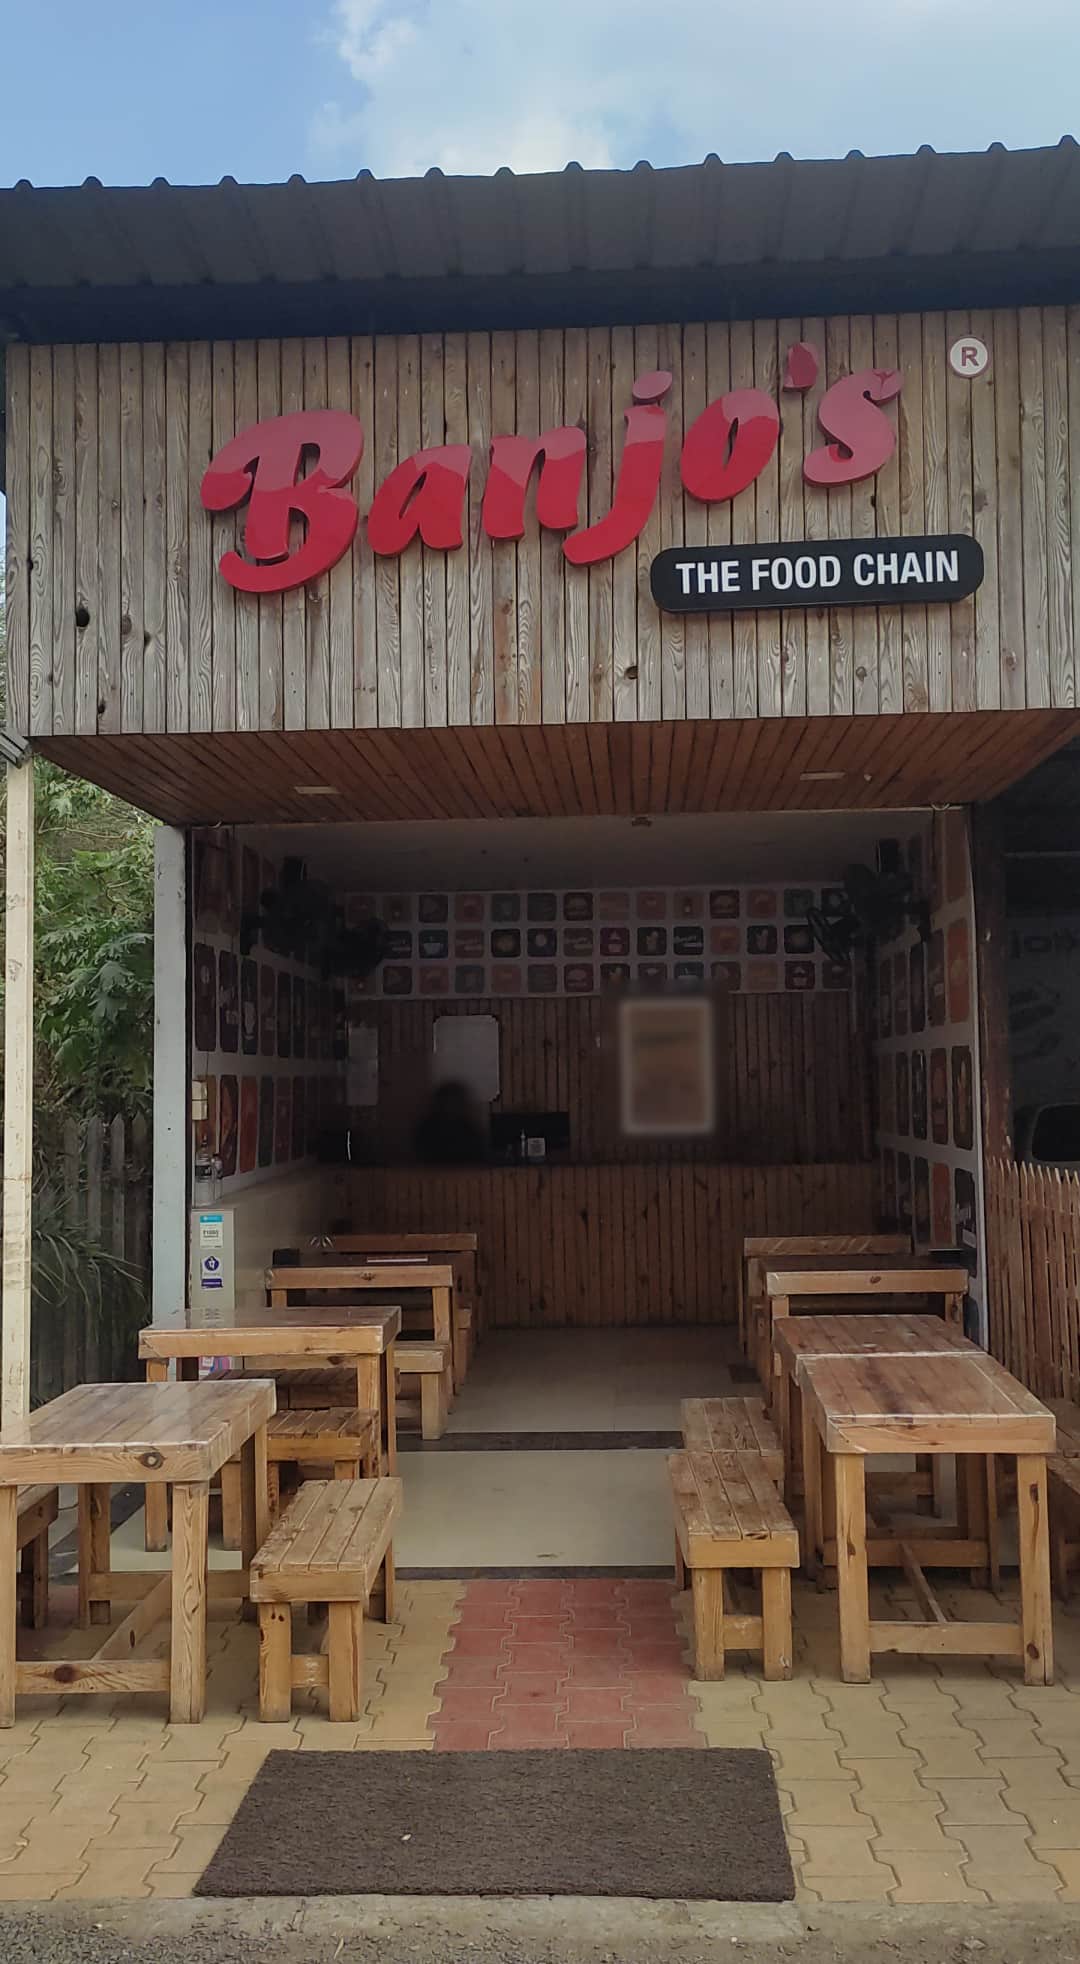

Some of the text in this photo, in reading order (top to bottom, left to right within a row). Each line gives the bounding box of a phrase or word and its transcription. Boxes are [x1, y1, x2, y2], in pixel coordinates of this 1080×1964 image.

[200, 342, 903, 593] Banjo's
[675, 550, 959, 594] THE FOOD CHAIN
